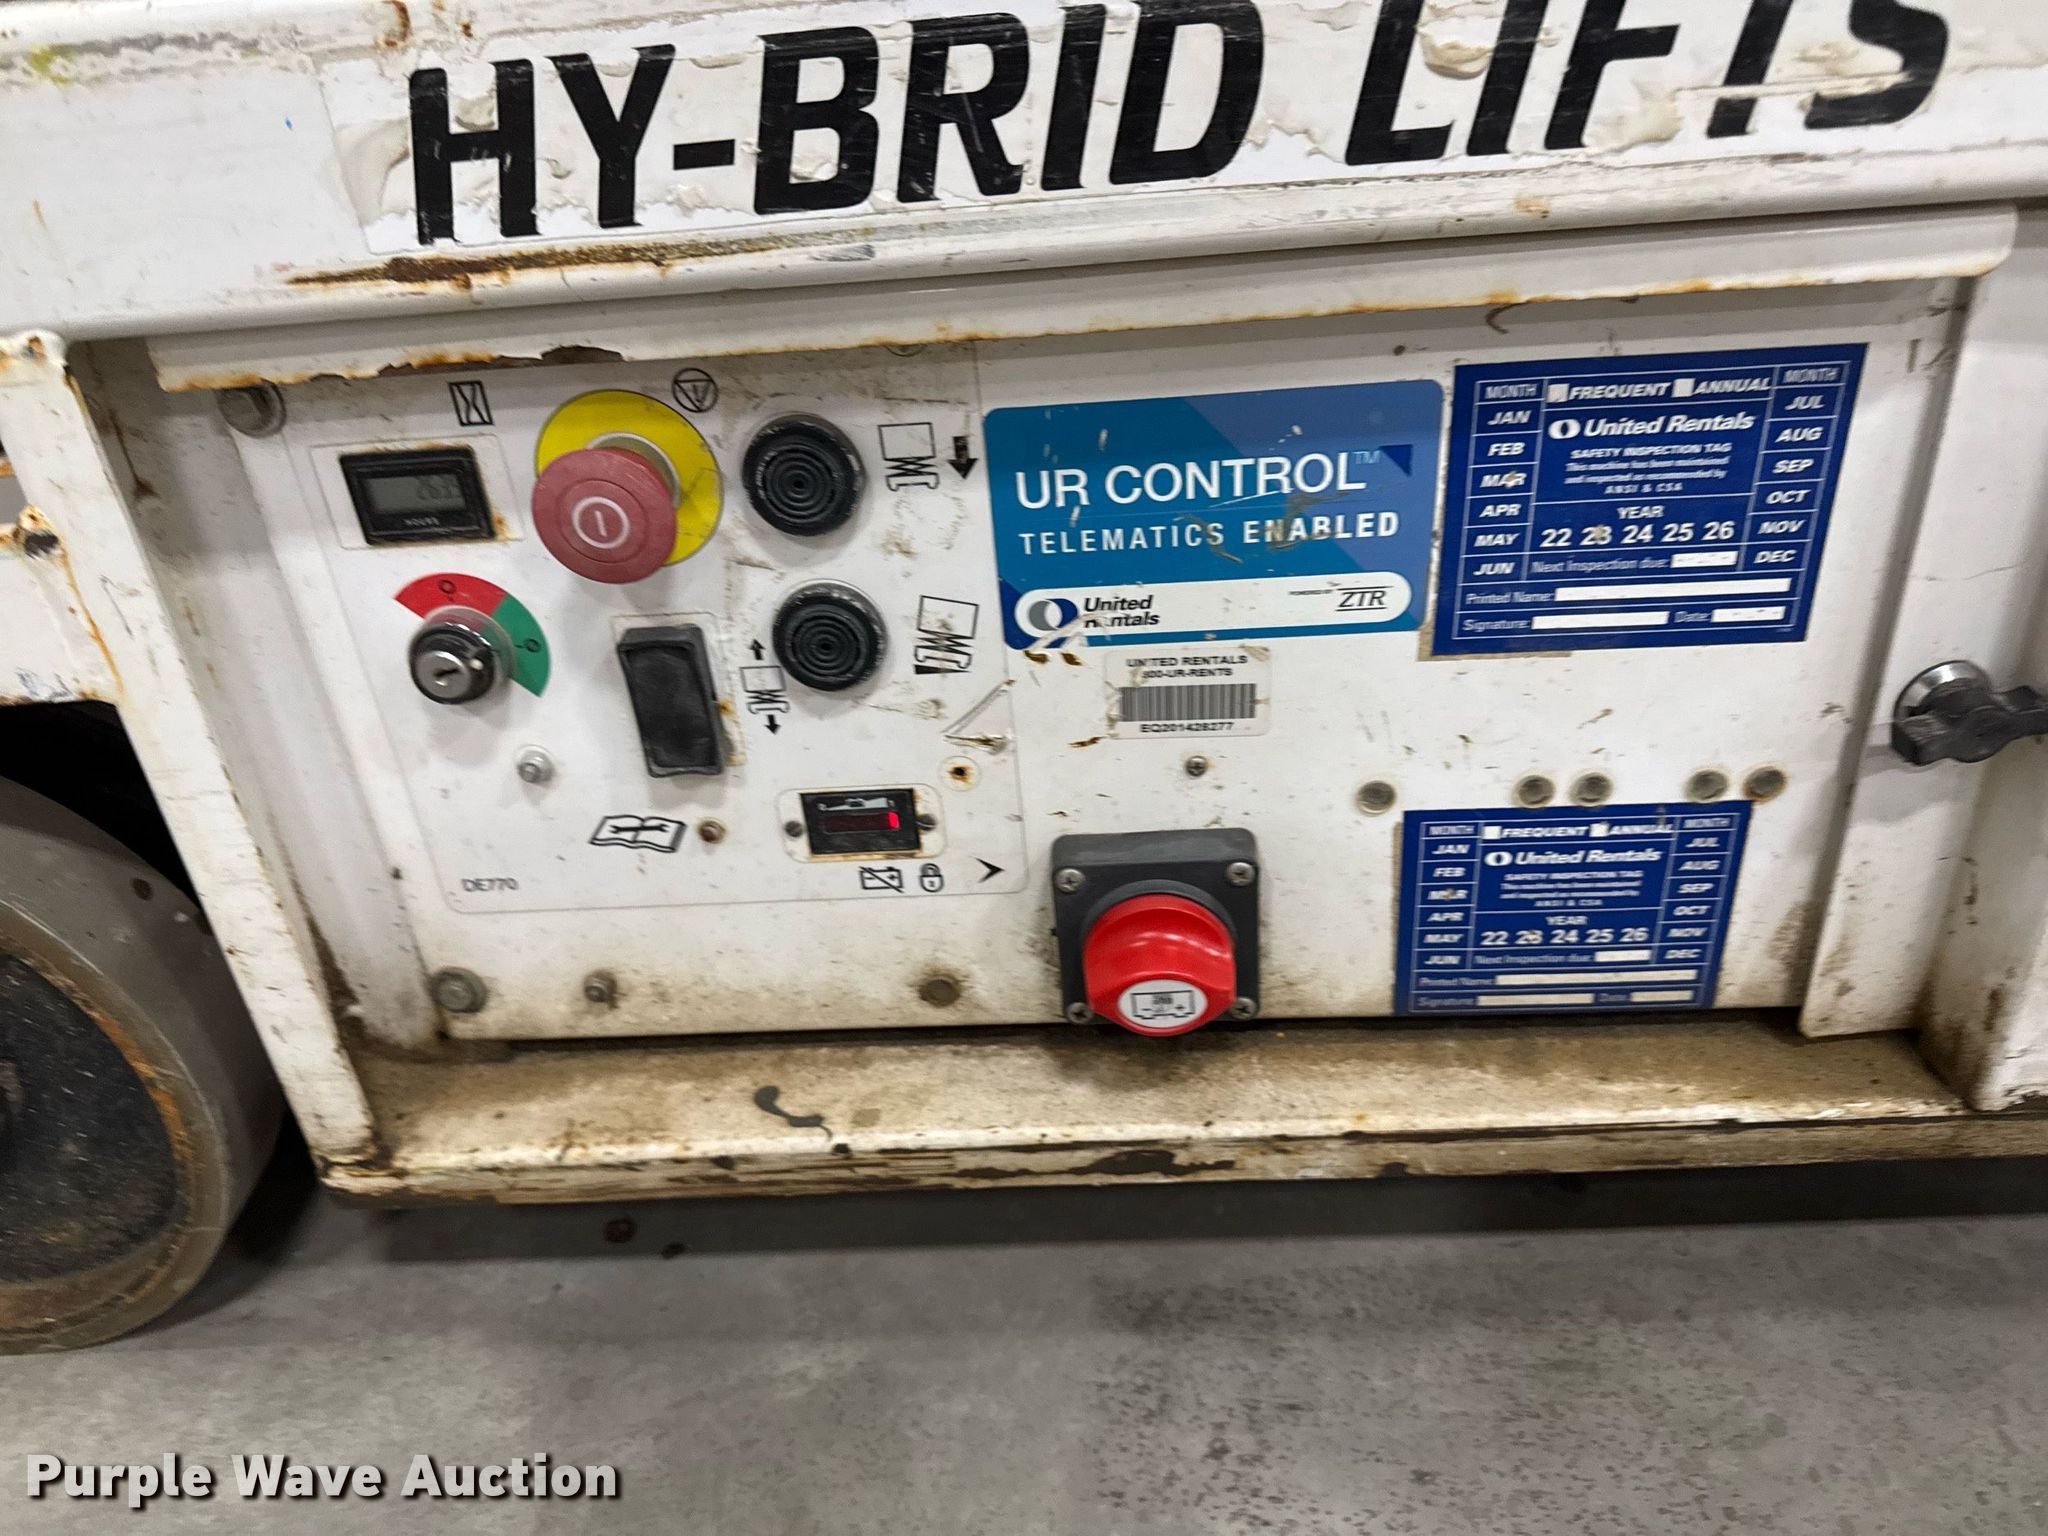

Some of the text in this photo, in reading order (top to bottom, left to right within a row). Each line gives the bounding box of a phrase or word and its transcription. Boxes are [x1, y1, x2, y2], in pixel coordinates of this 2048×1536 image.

[409, 0, 1264, 247] HY-BRID
[1784, 368, 1839, 383] MONTH
[1485, 384, 1537, 399] MONTH
[1569, 382, 1671, 400] FREQUENT
[1694, 377, 1771, 395] ANNUAL
[1784, 395, 1824, 410] JUL
[1487, 410, 1531, 425] JAN
[1583, 411, 1757, 437] United Rentals
[1775, 427, 1823, 443] AUG
[1487, 442, 1525, 456] FEB
[1570, 447, 1623, 459] SAFETY
[1704, 442, 1732, 453] TAG
[1772, 459, 1814, 473] SEP
[1016, 452, 1367, 509] UR CONTROL
[1480, 472, 1527, 488] MAR
[1766, 489, 1812, 504] OCT
[1479, 504, 1521, 517] APR
[1617, 505, 1664, 520] YEAR
[1018, 511, 1399, 556] TELEMATICS ENABLED
[1620, 525, 1653, 544] 24
[1661, 523, 1694, 542] 25
[1702, 521, 1735, 541] 26
[1757, 520, 1807, 534] NOV
[1474, 533, 1520, 547] MAY
[1540, 528, 1572, 548] 22
[1580, 525, 1612, 546] 23
[1754, 549, 1797, 563] DEC
[1473, 562, 1516, 576] JUN
[1533, 560, 1565, 575] Next
[1566, 557, 1638, 574] Inspection
[1084, 594, 1154, 612] United
[1338, 590, 1387, 608] ZTR
[1181, 655, 1248, 666] RENTALS
[1502, 826, 1589, 838] FREQUENT
[1431, 844, 1470, 855] JAN
[1685, 837, 1720, 848] JUL
[1514, 848, 1663, 865] United Rentals
[1432, 867, 1466, 877] FEB
[1678, 860, 1720, 871] AUG
[462, 877, 519, 893] DE770
[1677, 883, 1714, 893] SEP
[1428, 912, 1464, 922] APR
[1673, 905, 1711, 916] OCT
[1546, 915, 1588, 926] YEAR
[1424, 933, 1462, 943] MAY
[1480, 931, 1508, 946] 22
[1515, 930, 1543, 945] 23
[1550, 929, 1579, 944] 24
[1585, 928, 1614, 943] 25
[1619, 927, 1649, 942] 26
[1667, 927, 1707, 938] NOV
[1425, 955, 1461, 965] JUN
[1664, 949, 1703, 959] DEC
